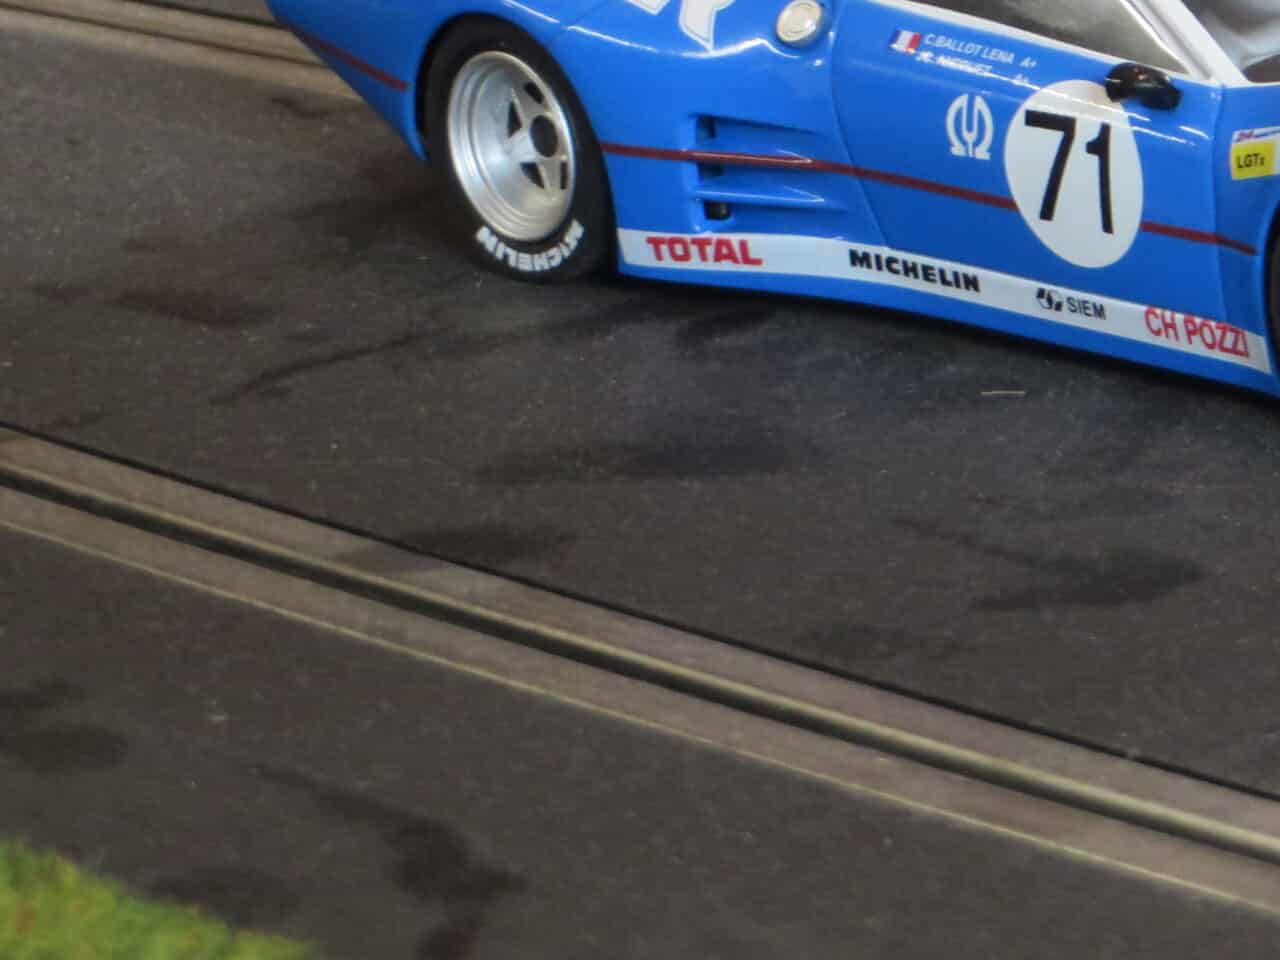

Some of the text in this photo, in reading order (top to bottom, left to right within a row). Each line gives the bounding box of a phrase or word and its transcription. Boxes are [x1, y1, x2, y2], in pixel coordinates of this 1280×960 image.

[1025, 109, 1114, 234] 71
[645, 236, 764, 266] TOTAL
[848, 248, 981, 293] MICHELIN
[1066, 296, 1107, 320] SIEM
[1144, 306, 1180, 342] CH
